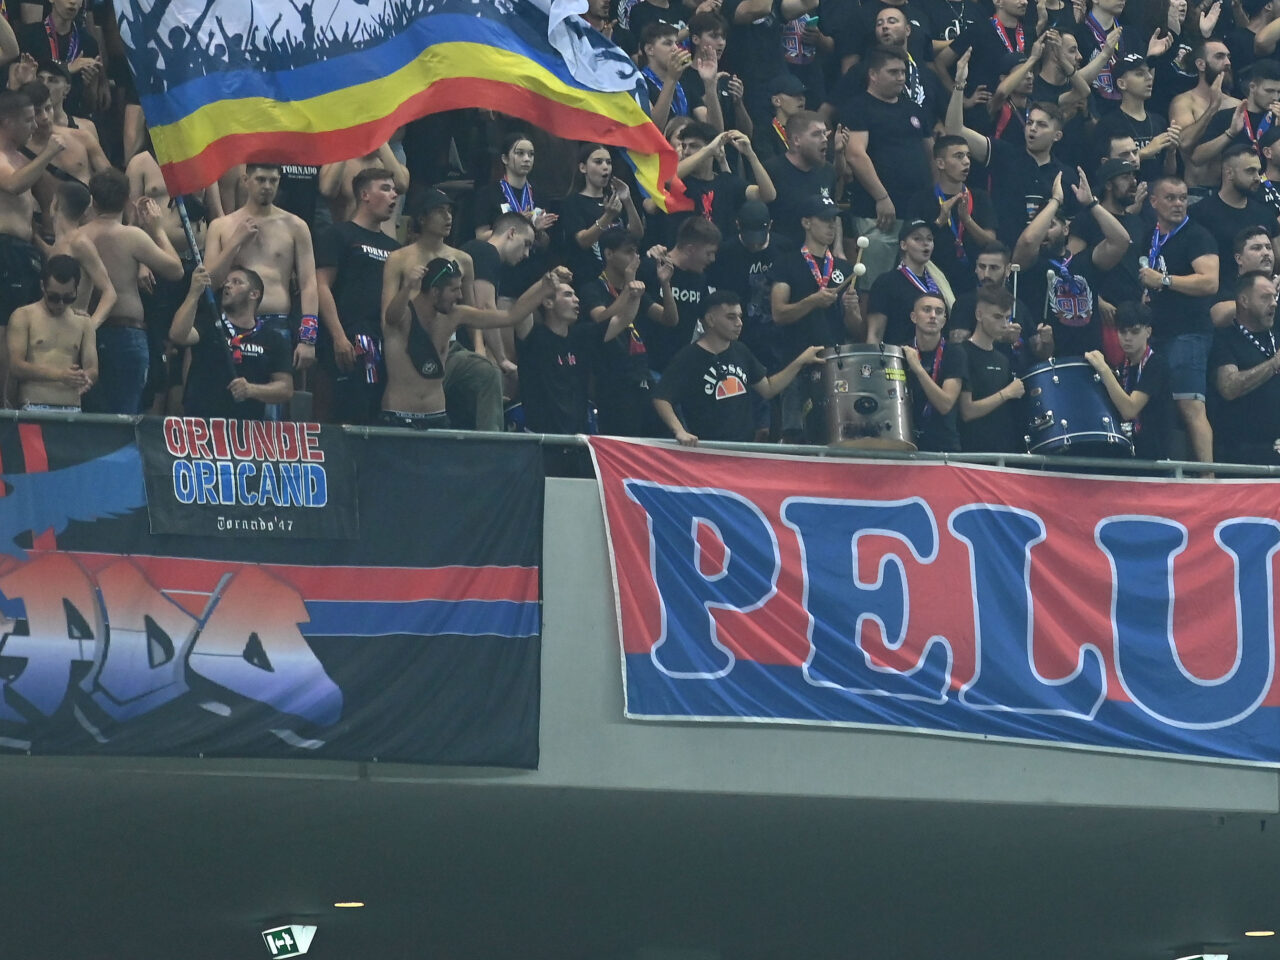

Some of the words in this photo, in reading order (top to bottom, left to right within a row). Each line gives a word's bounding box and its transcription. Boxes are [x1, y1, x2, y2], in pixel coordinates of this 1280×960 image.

[280, 165, 318, 176] TORNADO
[361, 244, 391, 259] TORNA
[163, 416, 325, 462] ORIUNDE
[173, 459, 328, 508] ORICAND
